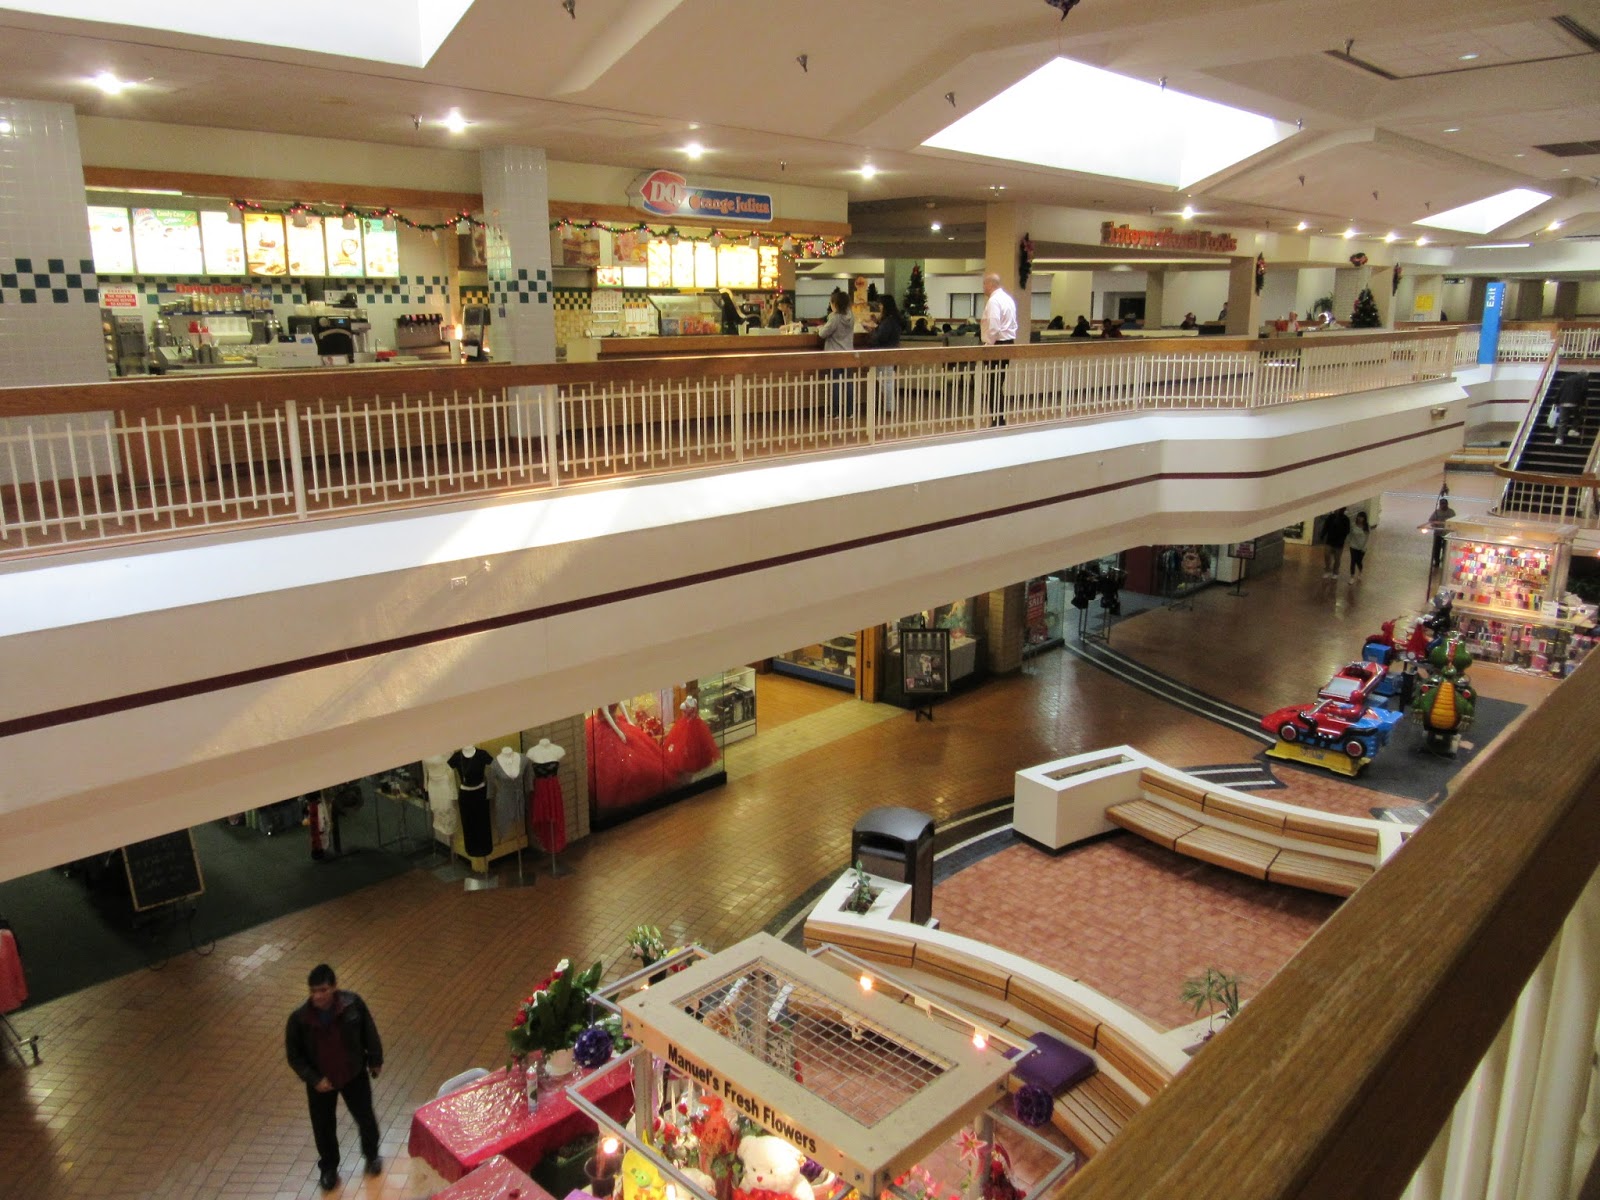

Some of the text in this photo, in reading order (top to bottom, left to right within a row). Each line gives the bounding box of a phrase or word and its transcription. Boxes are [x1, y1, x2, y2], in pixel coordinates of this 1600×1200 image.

[650, 180, 682, 206] DQ
[689, 192, 770, 214] Orange Julius
[1101, 221, 1200, 249] International
[1486, 287, 1497, 308] Exit
[667, 1043, 817, 1154] Manuel's Fresh Flowers
